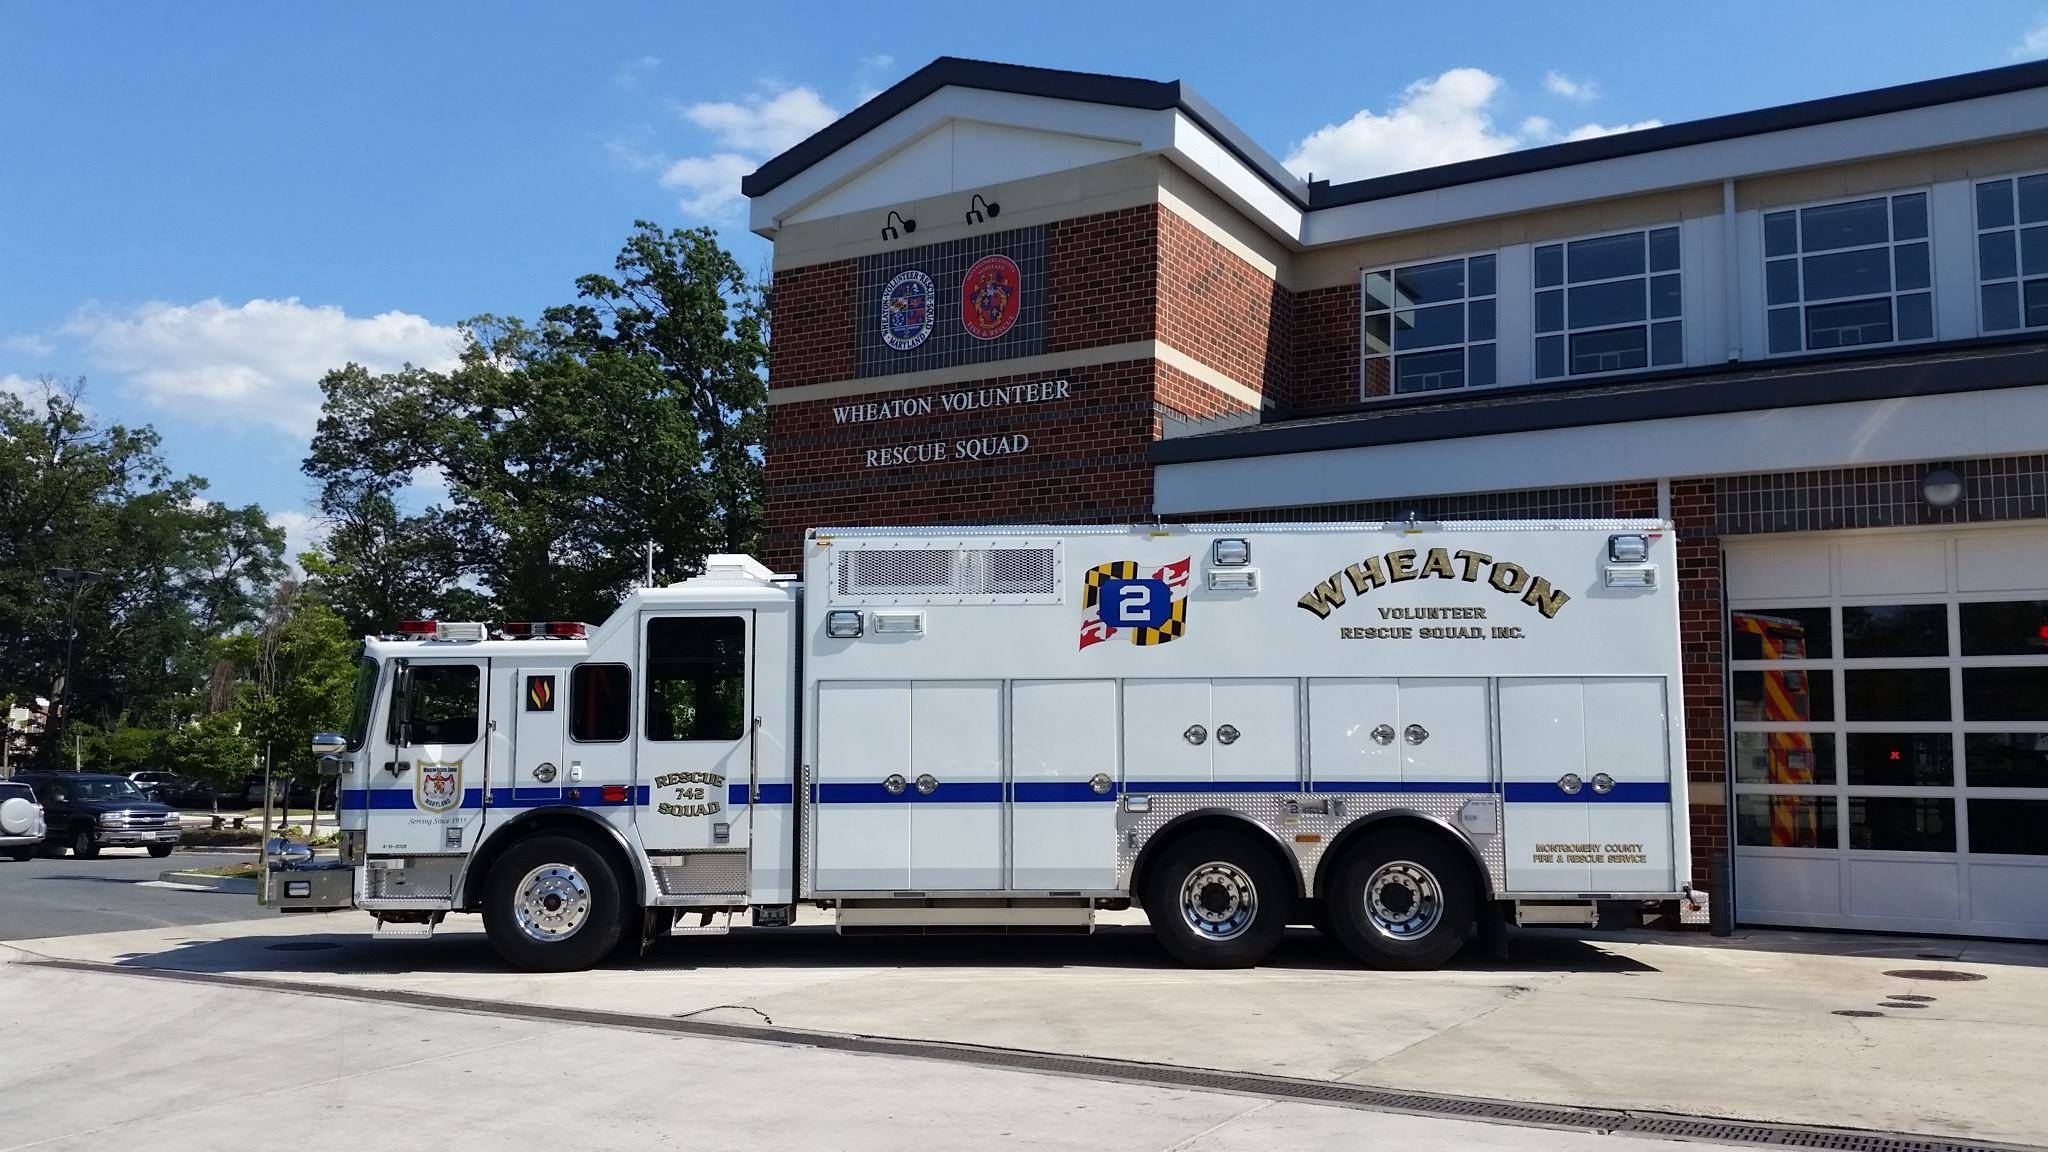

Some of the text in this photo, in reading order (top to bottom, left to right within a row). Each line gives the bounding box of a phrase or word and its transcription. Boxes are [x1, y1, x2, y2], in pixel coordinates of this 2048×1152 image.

[881, 271, 935, 336] WHEATON VOLUNTEER RESCUE SQUAD
[889, 333, 926, 349] MARYLAND
[833, 379, 1071, 424] WHEATON VOLUNTEER
[866, 434, 1029, 468] RESCUE SQUAD
[1297, 547, 1572, 620] WHEATON
[1119, 585, 1151, 621] 2
[1378, 607, 1487, 620] VOLUNTEER
[1340, 626, 1526, 641] RESCUE SQUAD, INC.
[654, 772, 726, 789] RESCUE
[675, 788, 704, 800] 742
[425, 798, 451, 808] MARYLAND
[658, 801, 721, 817] SQUAD
[408, 818, 432, 826] Serving
[1535, 844, 1644, 853] MONTGOMERY COUNTY
[1532, 855, 1647, 863] FIRE & RESCUE SERVICE
